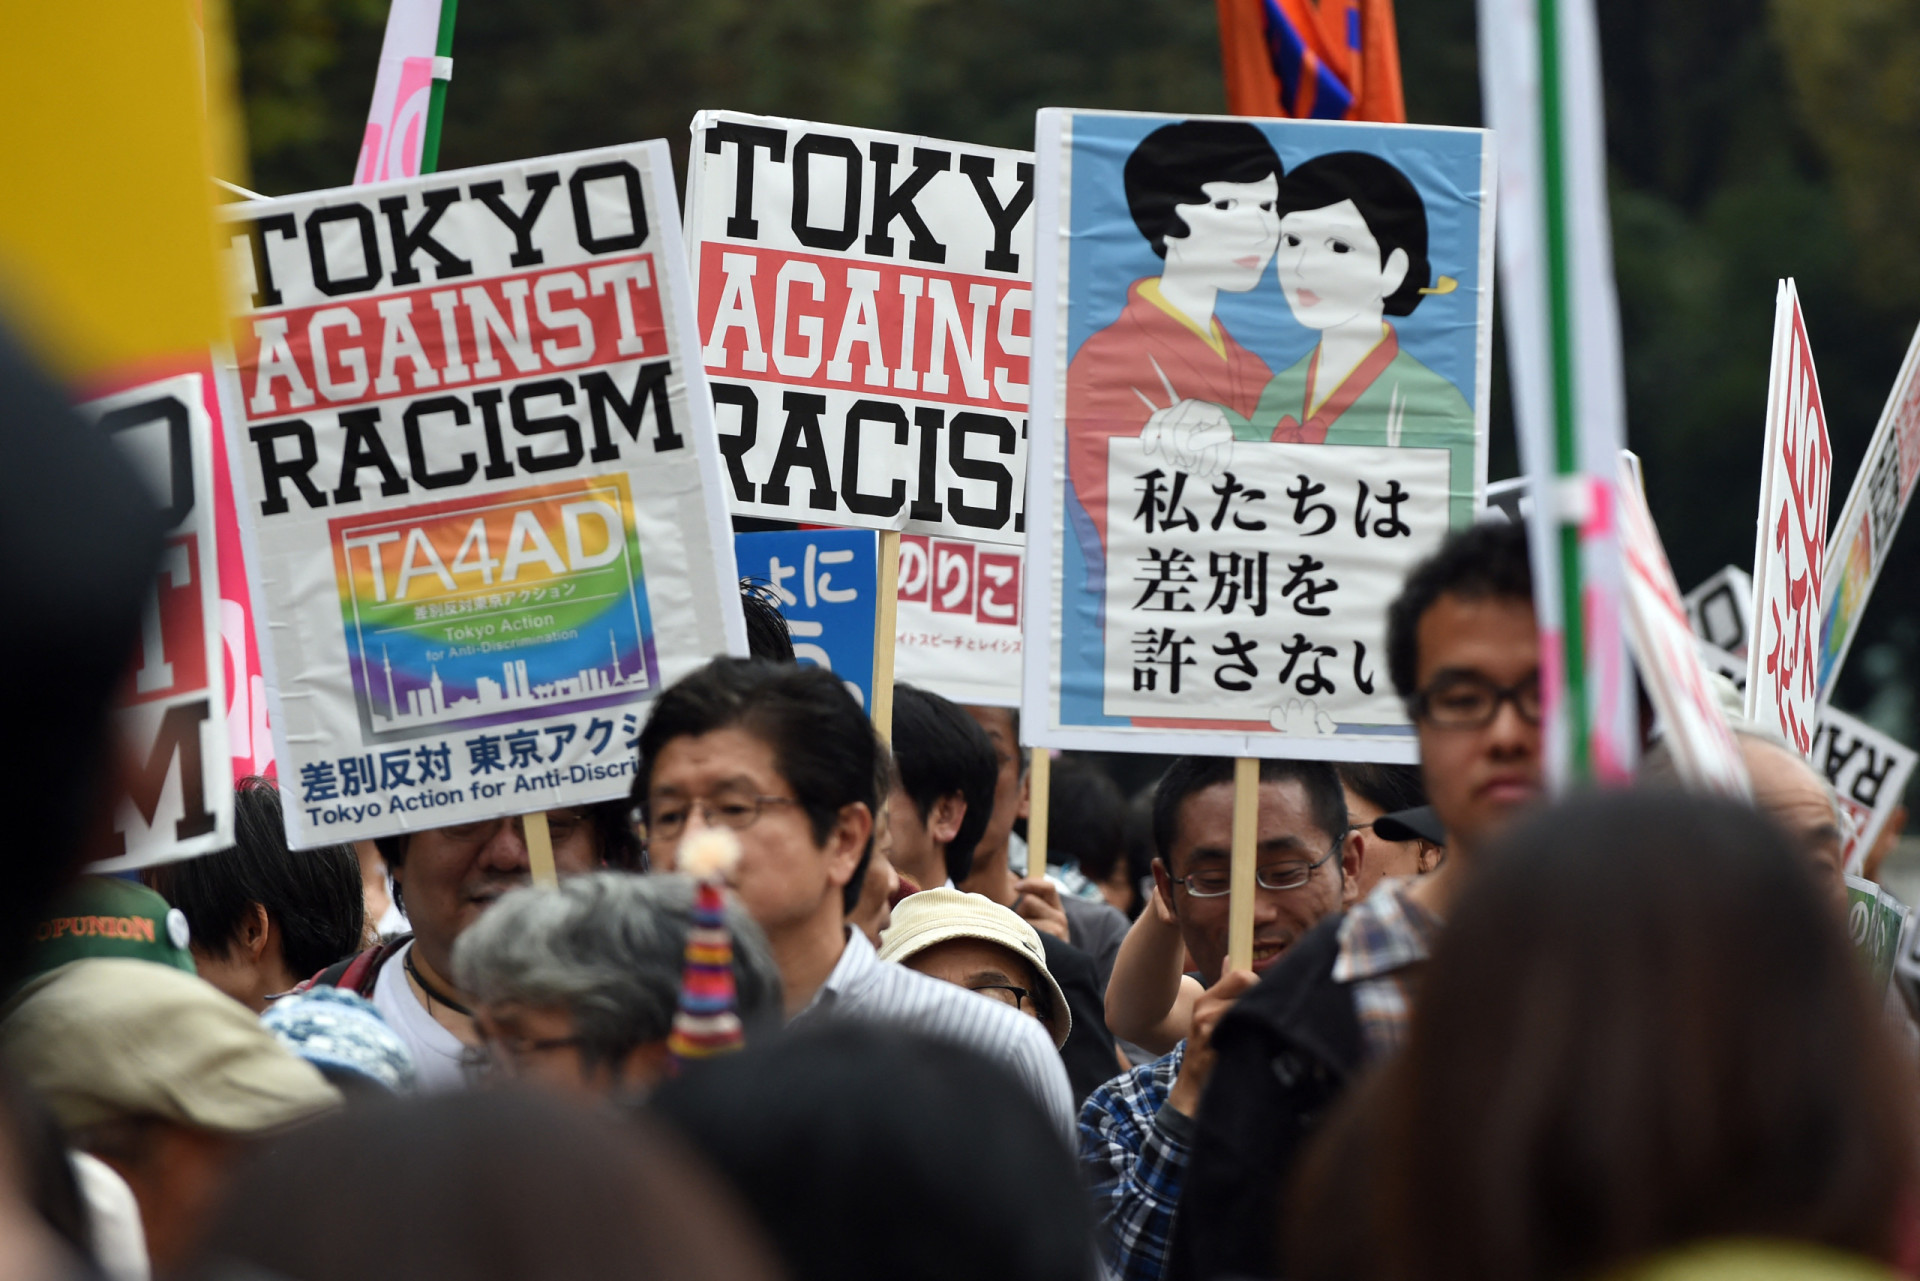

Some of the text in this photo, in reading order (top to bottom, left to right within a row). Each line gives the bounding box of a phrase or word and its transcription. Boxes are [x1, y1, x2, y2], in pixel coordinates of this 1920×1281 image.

[222, 160, 649, 308] TOKYO
[250, 258, 652, 415] AGAINST
[248, 360, 685, 516] RACISM
[709, 384, 1028, 533] RACIS
[1786, 332, 1828, 586] NO!
[1132, 468, 1411, 539] 私たちは
[345, 501, 626, 603] TA4AD
[1131, 547, 1339, 617] 差別を
[414, 583, 577, 621] 差別反対東京アクション
[444, 614, 555, 642] Tokyo Action
[425, 628, 579, 662] for Anti-Discrimination
[299, 741, 453, 803] 差別反対
[306, 802, 382, 827] Tokyo
[389, 786, 464, 815] Action
[469, 779, 506, 799] for
[34, 915, 156, 943] OPUNION
